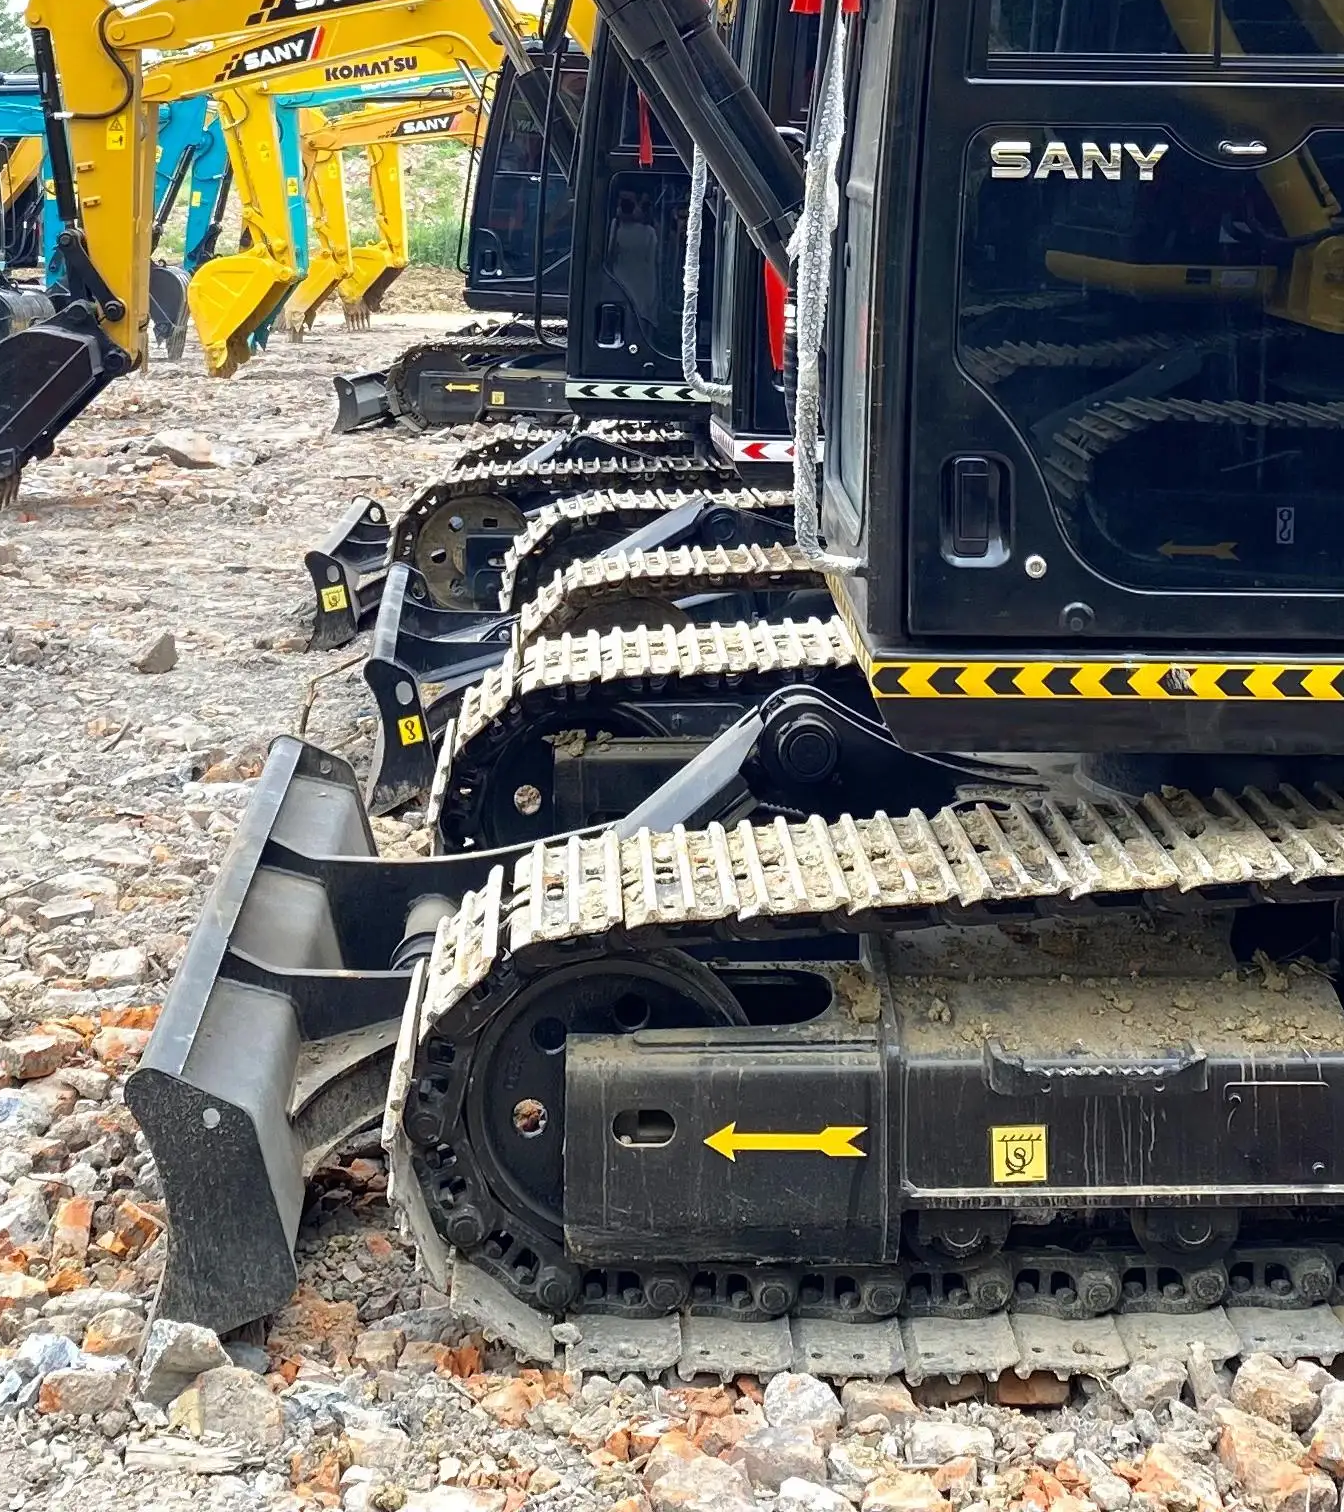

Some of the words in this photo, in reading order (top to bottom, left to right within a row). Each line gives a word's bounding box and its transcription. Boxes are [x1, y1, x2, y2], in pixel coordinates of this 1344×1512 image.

[242, 39, 305, 71] SANY
[325, 55, 418, 82] KOMATSU
[402, 116, 450, 134] SANY
[990, 141, 1169, 181] SANY
